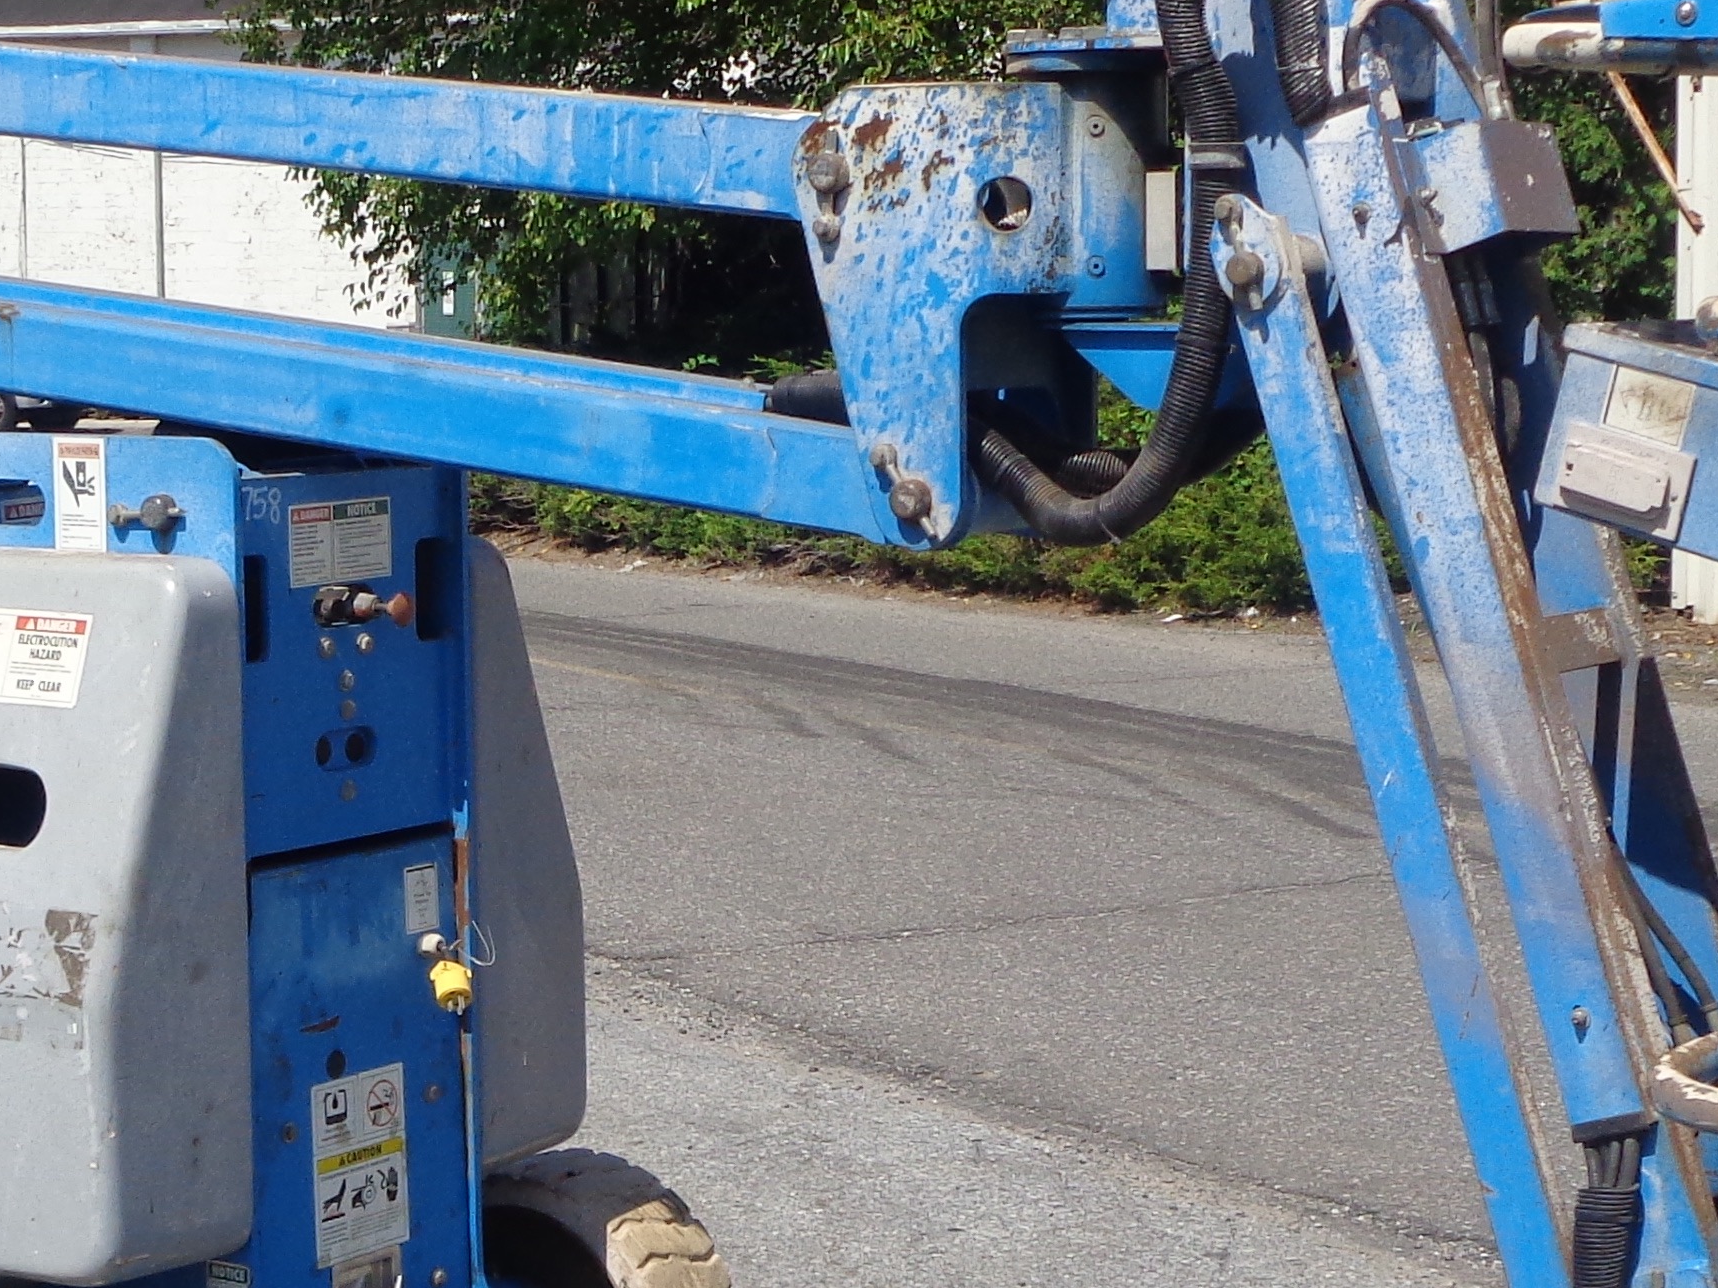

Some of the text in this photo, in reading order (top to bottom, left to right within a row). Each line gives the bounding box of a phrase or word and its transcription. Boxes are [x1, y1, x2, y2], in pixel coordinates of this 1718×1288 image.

[241, 486, 282, 524] 758
[347, 502, 377, 517] NOTICE
[36, 619, 78, 633] DANGER
[17, 633, 79, 648] ELECTROCUTION
[29, 648, 62, 661] HAZARD
[15, 679, 62, 693] KEEP CLEAR
[347, 1144, 383, 1164] CAUTION
